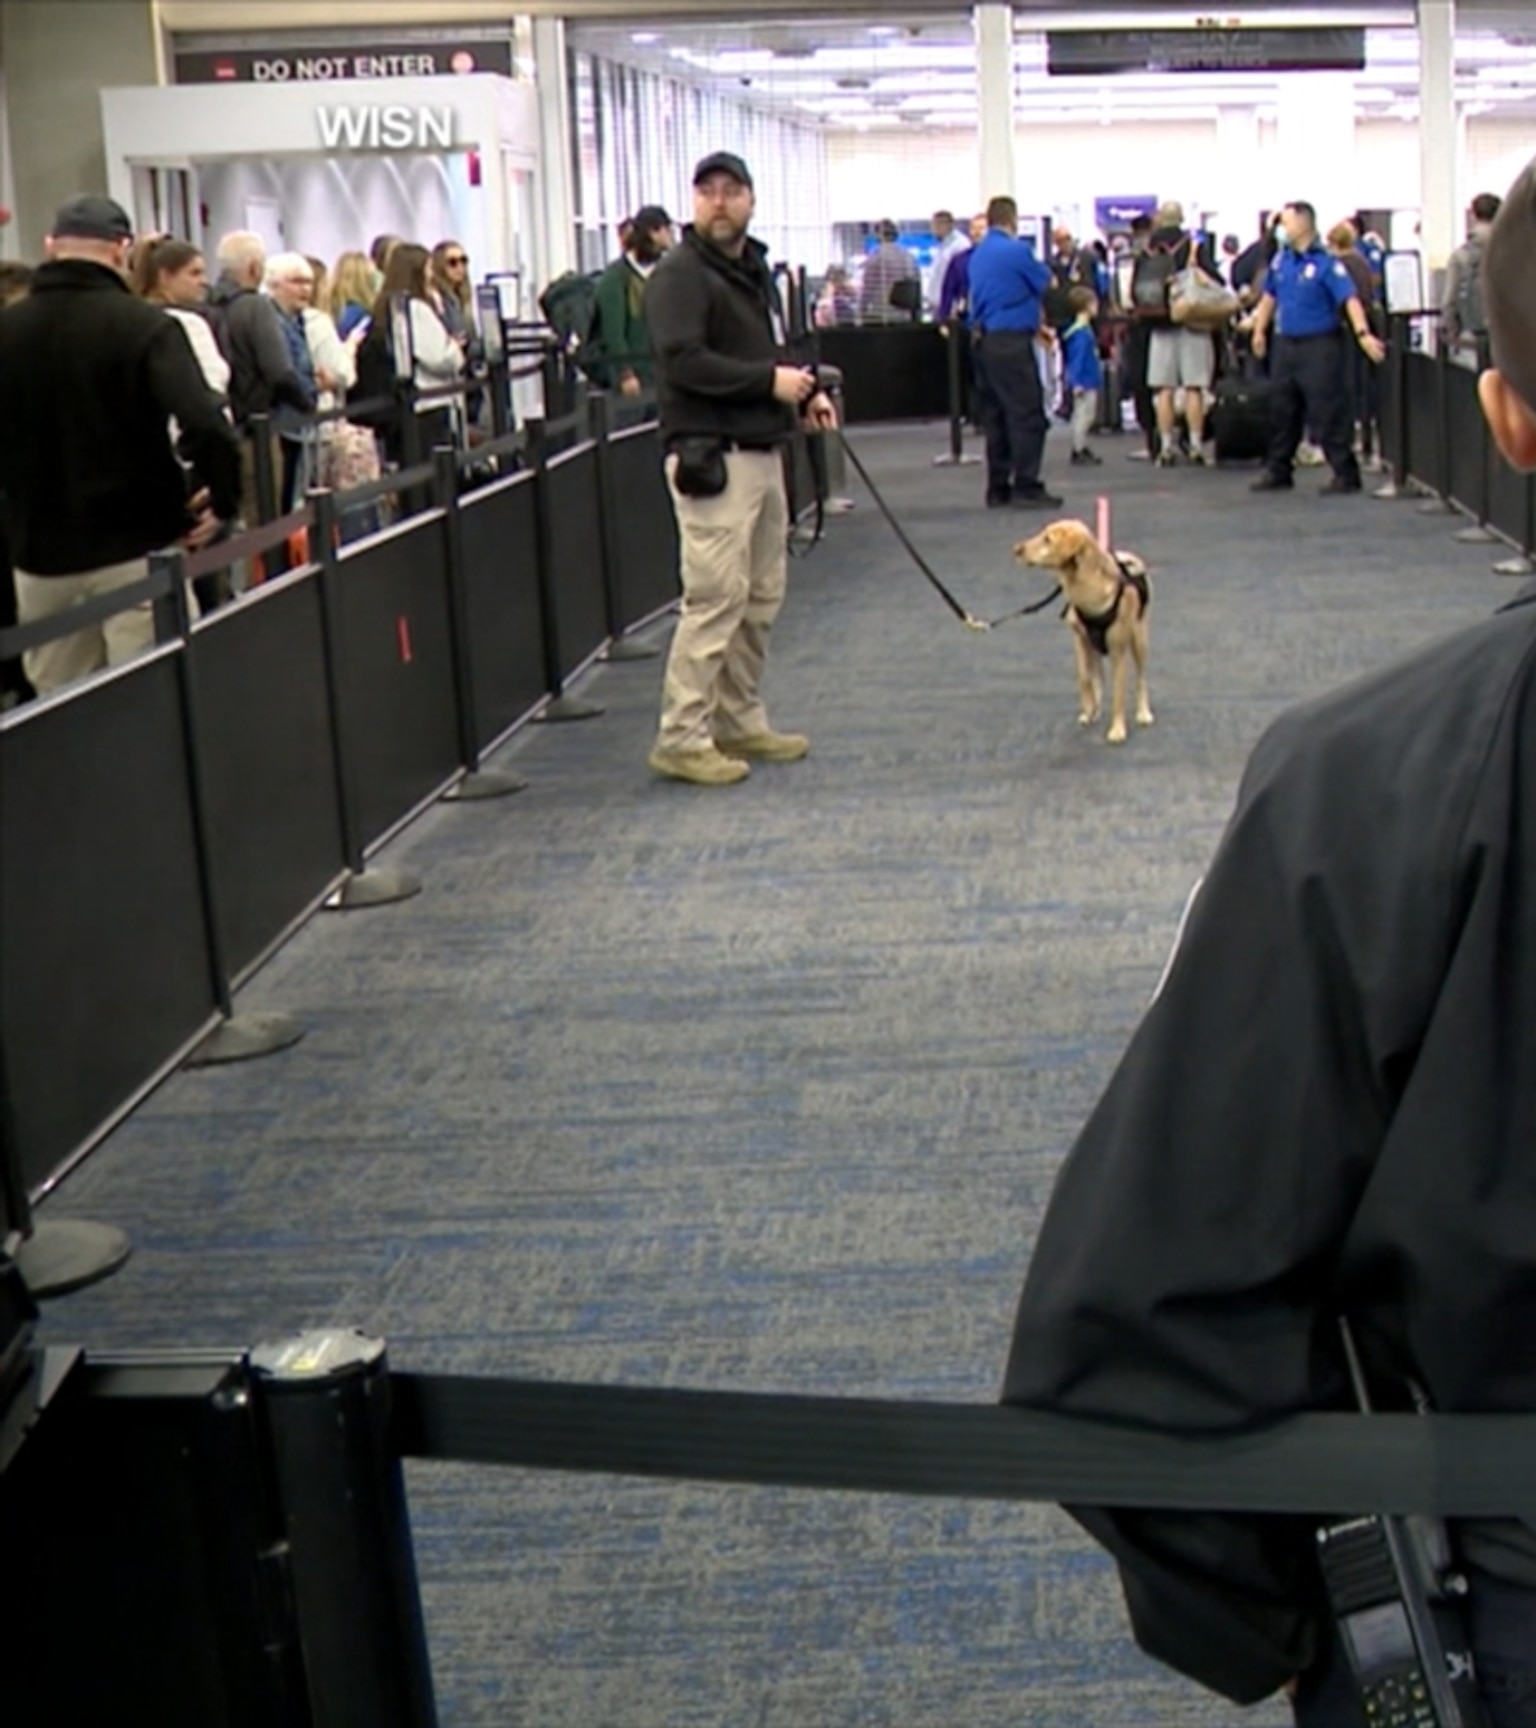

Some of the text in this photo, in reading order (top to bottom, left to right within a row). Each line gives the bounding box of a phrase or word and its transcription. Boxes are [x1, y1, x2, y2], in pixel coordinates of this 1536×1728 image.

[252, 54, 435, 80] DO NOT ENTER
